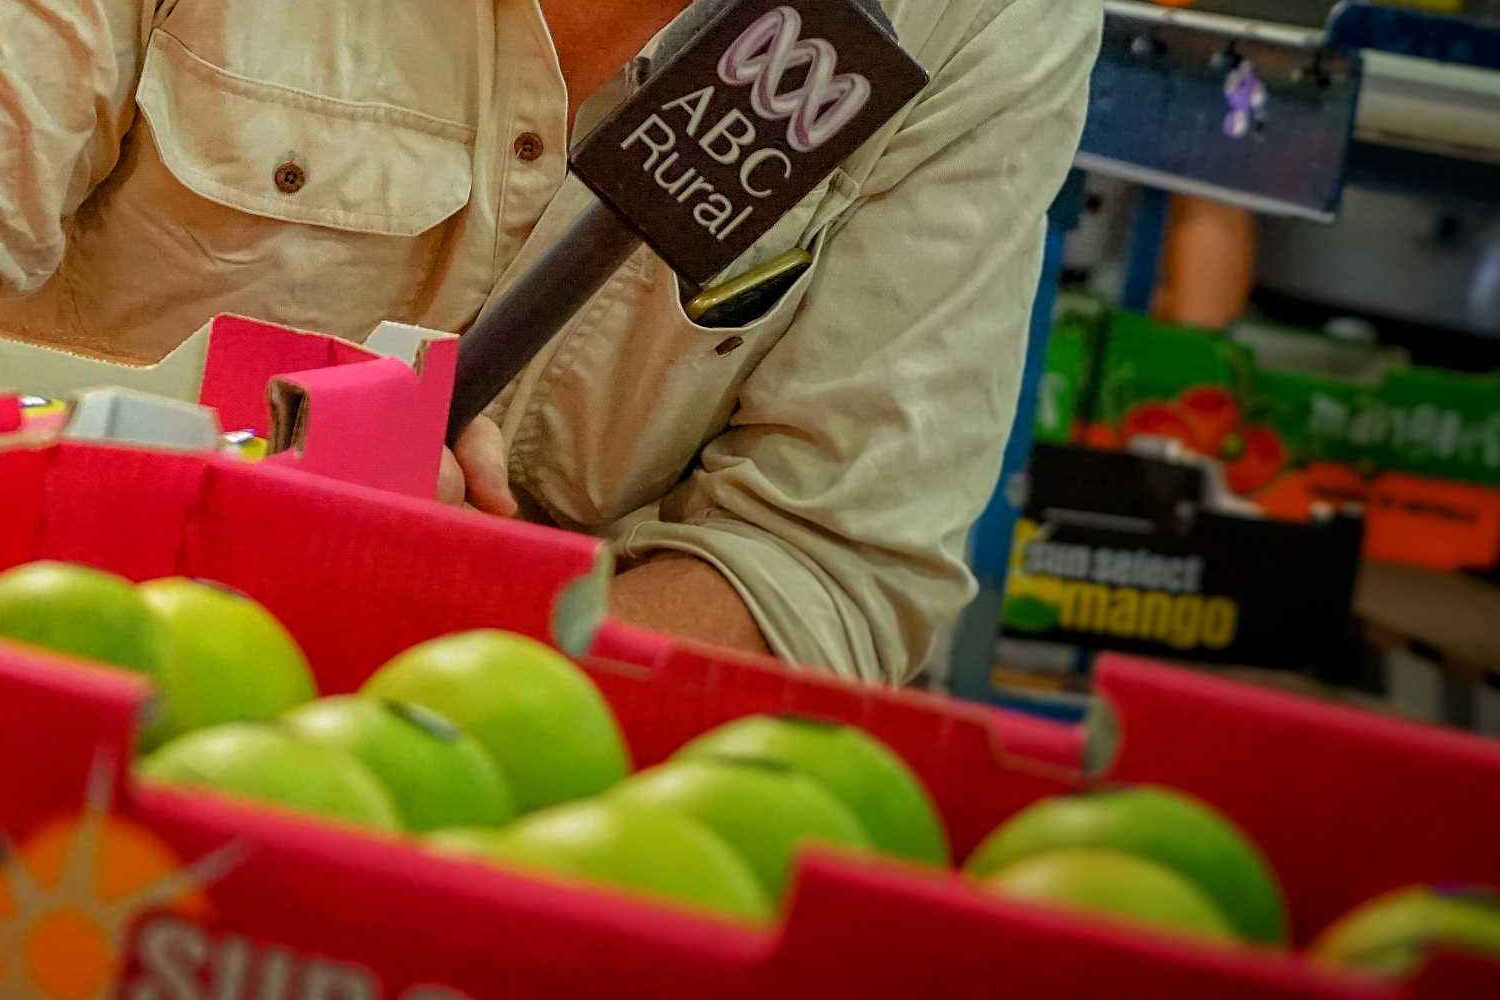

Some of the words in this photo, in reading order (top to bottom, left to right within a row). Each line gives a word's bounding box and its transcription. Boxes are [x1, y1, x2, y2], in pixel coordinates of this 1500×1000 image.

[620, 113, 754, 242] Rural
[661, 85, 792, 199] ABC
[1026, 541, 1091, 580] sun
[1092, 548, 1204, 594] select
[1060, 577, 1241, 651] mango
